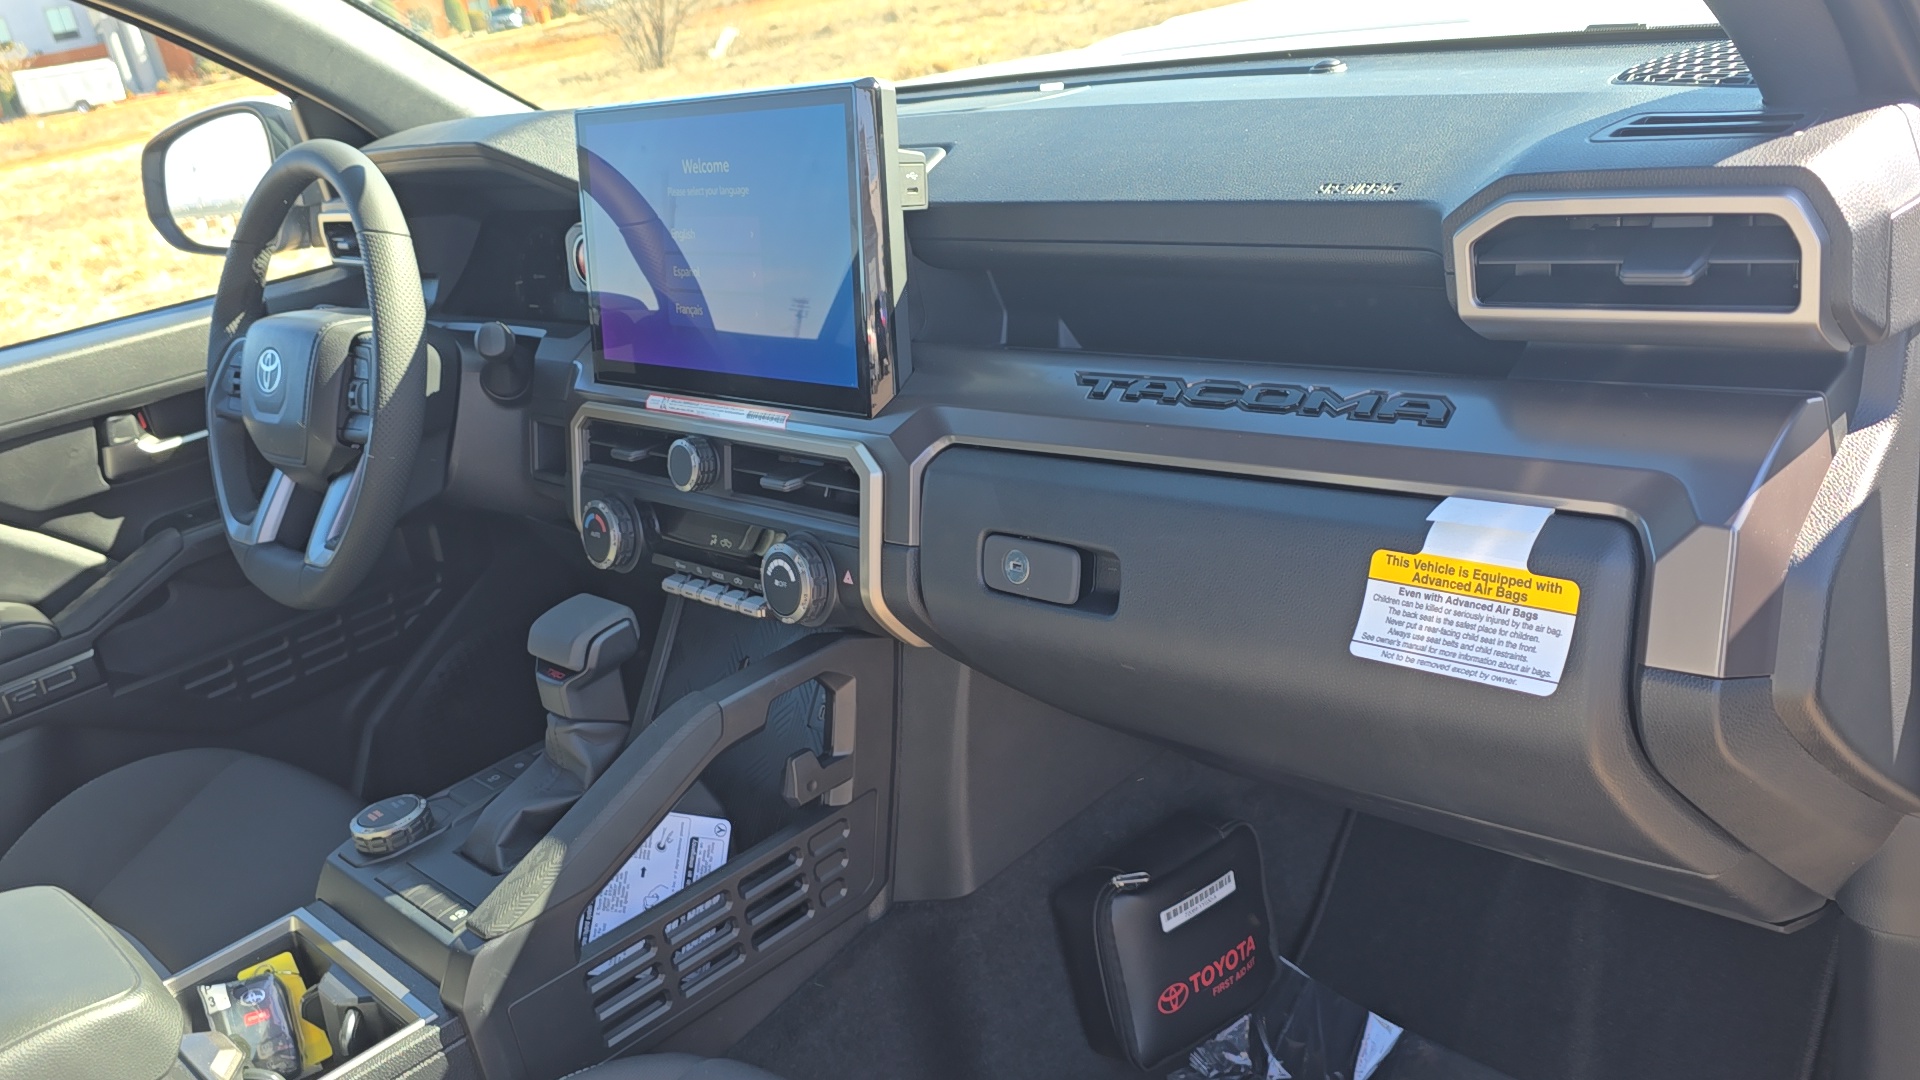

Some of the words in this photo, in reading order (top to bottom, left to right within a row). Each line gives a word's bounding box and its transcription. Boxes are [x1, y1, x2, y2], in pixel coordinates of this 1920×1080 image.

[681, 157, 730, 174] Welcome
[667, 187, 686, 197] Please
[705, 187, 719, 198] your
[719, 185, 749, 198] language
[671, 228, 696, 242] English
[675, 302, 703, 317] Français
[1075, 370, 1456, 428] TACOMA
[1386, 554, 1410, 568] This
[1414, 558, 1456, 576] Vehicle
[1459, 565, 1469, 578] is
[1473, 568, 1532, 589] Equipped
[1536, 581, 1563, 594] with
[1412, 572, 1472, 592] Advanced
[1474, 583, 1492, 596] Air
[1496, 586, 1528, 603] Bags
[1373, 593, 1400, 605] Children
[1401, 600, 1414, 608] can
[1415, 601, 1424, 610] be
[1425, 603, 1443, 613] killed
[1453, 609, 1484, 623] seriously
[1486, 614, 1509, 626] injured
[1511, 620, 1520, 629] by
[1522, 622, 1534, 630] the
[1535, 624, 1545, 632] air
[1547, 626, 1563, 638] bag.
[1398, 586, 1421, 599] Even
[1424, 592, 1443, 603] with
[1445, 596, 1494, 612] Advanced
[1495, 604, 1510, 615] Air
[1513, 607, 1538, 621] Bags
[1385, 616, 1405, 627] Never
[1406, 621, 1418, 630] put
[1424, 624, 1461, 640] rear-facing
[1462, 631, 1479, 642] child
[1480, 636, 1496, 645] seat
[1497, 638, 1504, 646] in
[1505, 639, 1517, 648] the
[1519, 642, 1537, 654] front.
[1389, 606, 1401, 616] The
[1402, 609, 1418, 619] back
[1419, 612, 1434, 622] seat
[1443, 617, 1454, 626] the
[1455, 619, 1476, 630] safest
[1477, 624, 1497, 635] place
[1498, 628, 1508, 636] for
[1510, 630, 1540, 643] children.
[1361, 631, 1374, 641] See
[1376, 635, 1401, 647] owner's
[1402, 641, 1427, 654] manual
[1428, 646, 1438, 654] for
[1438, 649, 1457, 658] more
[1458, 651, 1497, 667] information
[1498, 661, 1519, 671] about
[1520, 665, 1531, 673] air
[1531, 667, 1551, 678] bags.
[1387, 628, 1411, 639] Always
[1412, 633, 1425, 641] use
[1426, 635, 1441, 644] seat
[1442, 638, 1459, 649] belts
[1460, 642, 1474, 651] and
[1475, 644, 1492, 655] child
[1493, 649, 1528, 663] restraints.
[1380, 650, 1393, 660] Not
[1396, 653, 1403, 661] to
[1405, 655, 1415, 663] be
[1417, 657, 1450, 671] removed
[1452, 665, 1478, 677] except
[1479, 671, 1489, 680] by
[1491, 674, 1517, 686] owner.
[1189, 935, 1256, 993] TOYOTA
[1212, 975, 1234, 997] FIRST
[1236, 966, 1247, 981] AID
[1247, 956, 1255, 971] KIT
